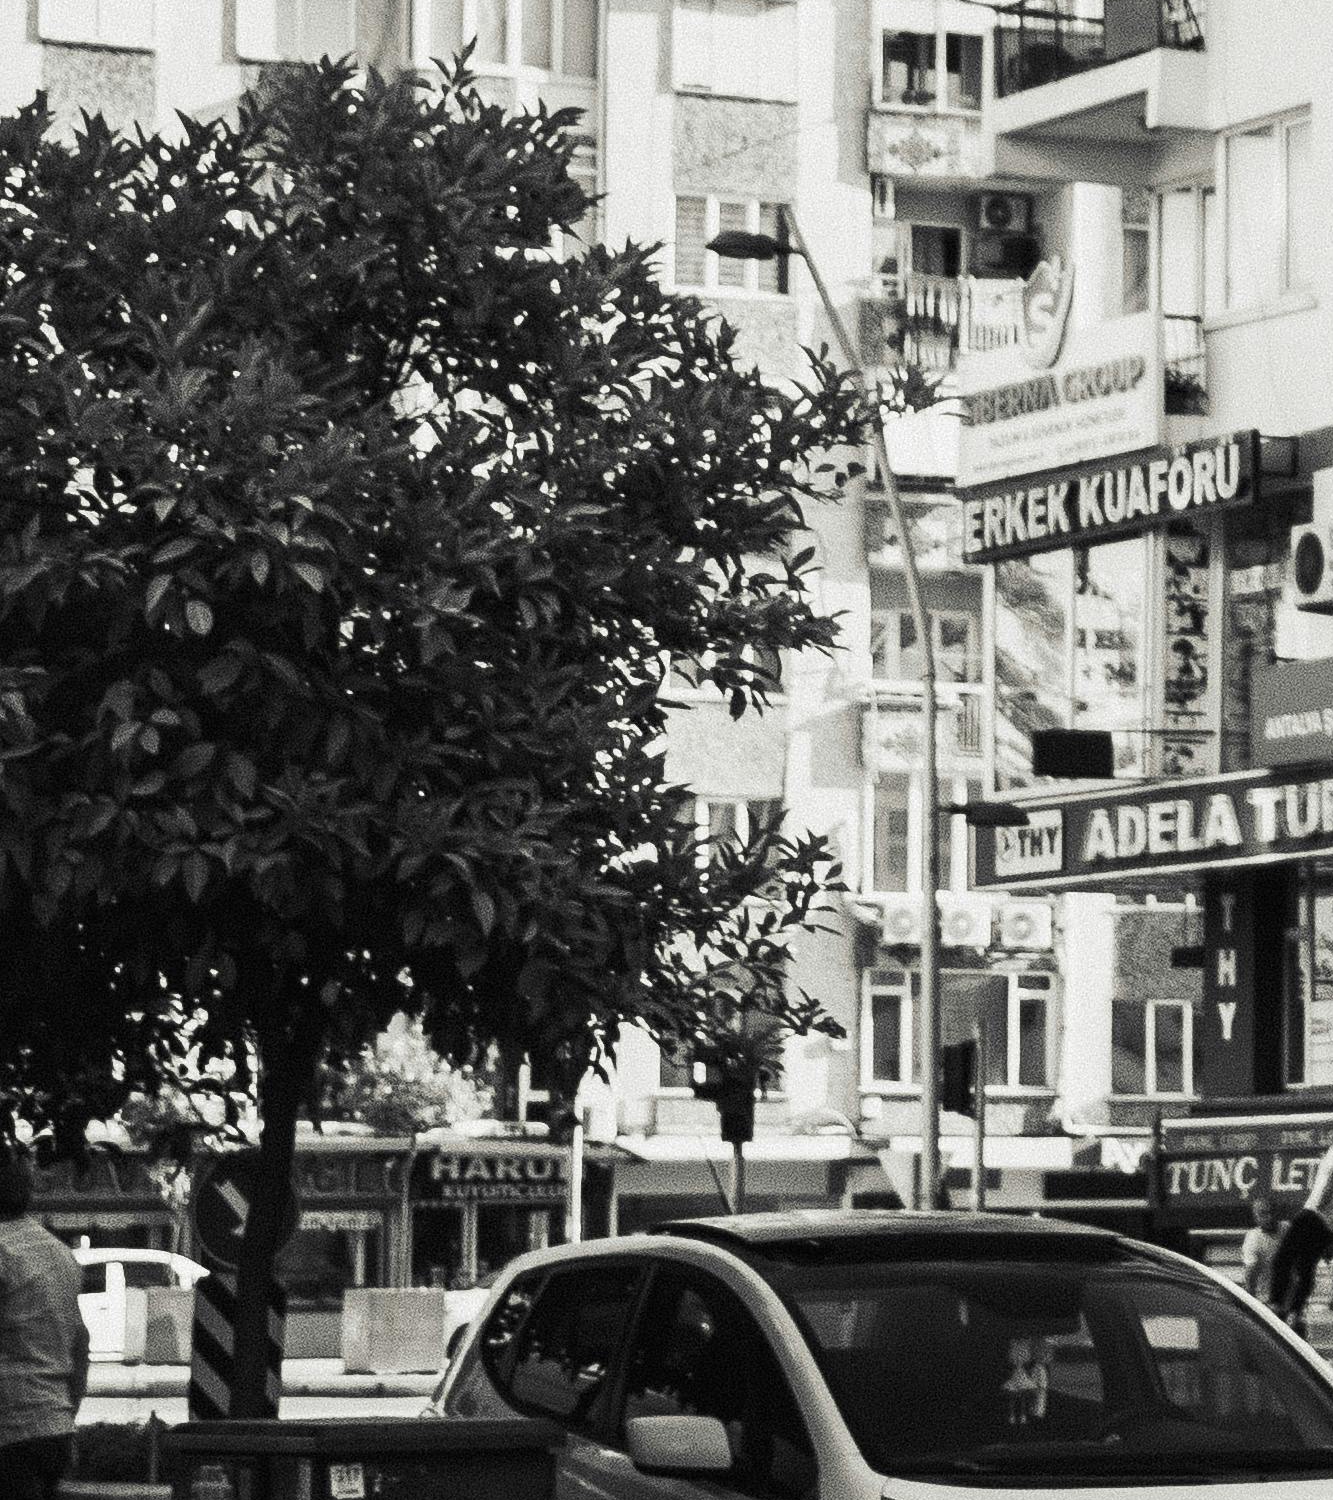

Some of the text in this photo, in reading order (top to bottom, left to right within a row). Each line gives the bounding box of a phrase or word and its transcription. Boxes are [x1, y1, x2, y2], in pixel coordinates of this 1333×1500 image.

[1064, 354, 1146, 404] GROUP
[964, 480, 1070, 554] ERKEK
[1078, 435, 1240, 529] KUAFÖRÜ
[1018, 825, 1059, 859] THY
[1083, 793, 1242, 862] ADELA
[1166, 1155, 1258, 1199] TUNÇ
